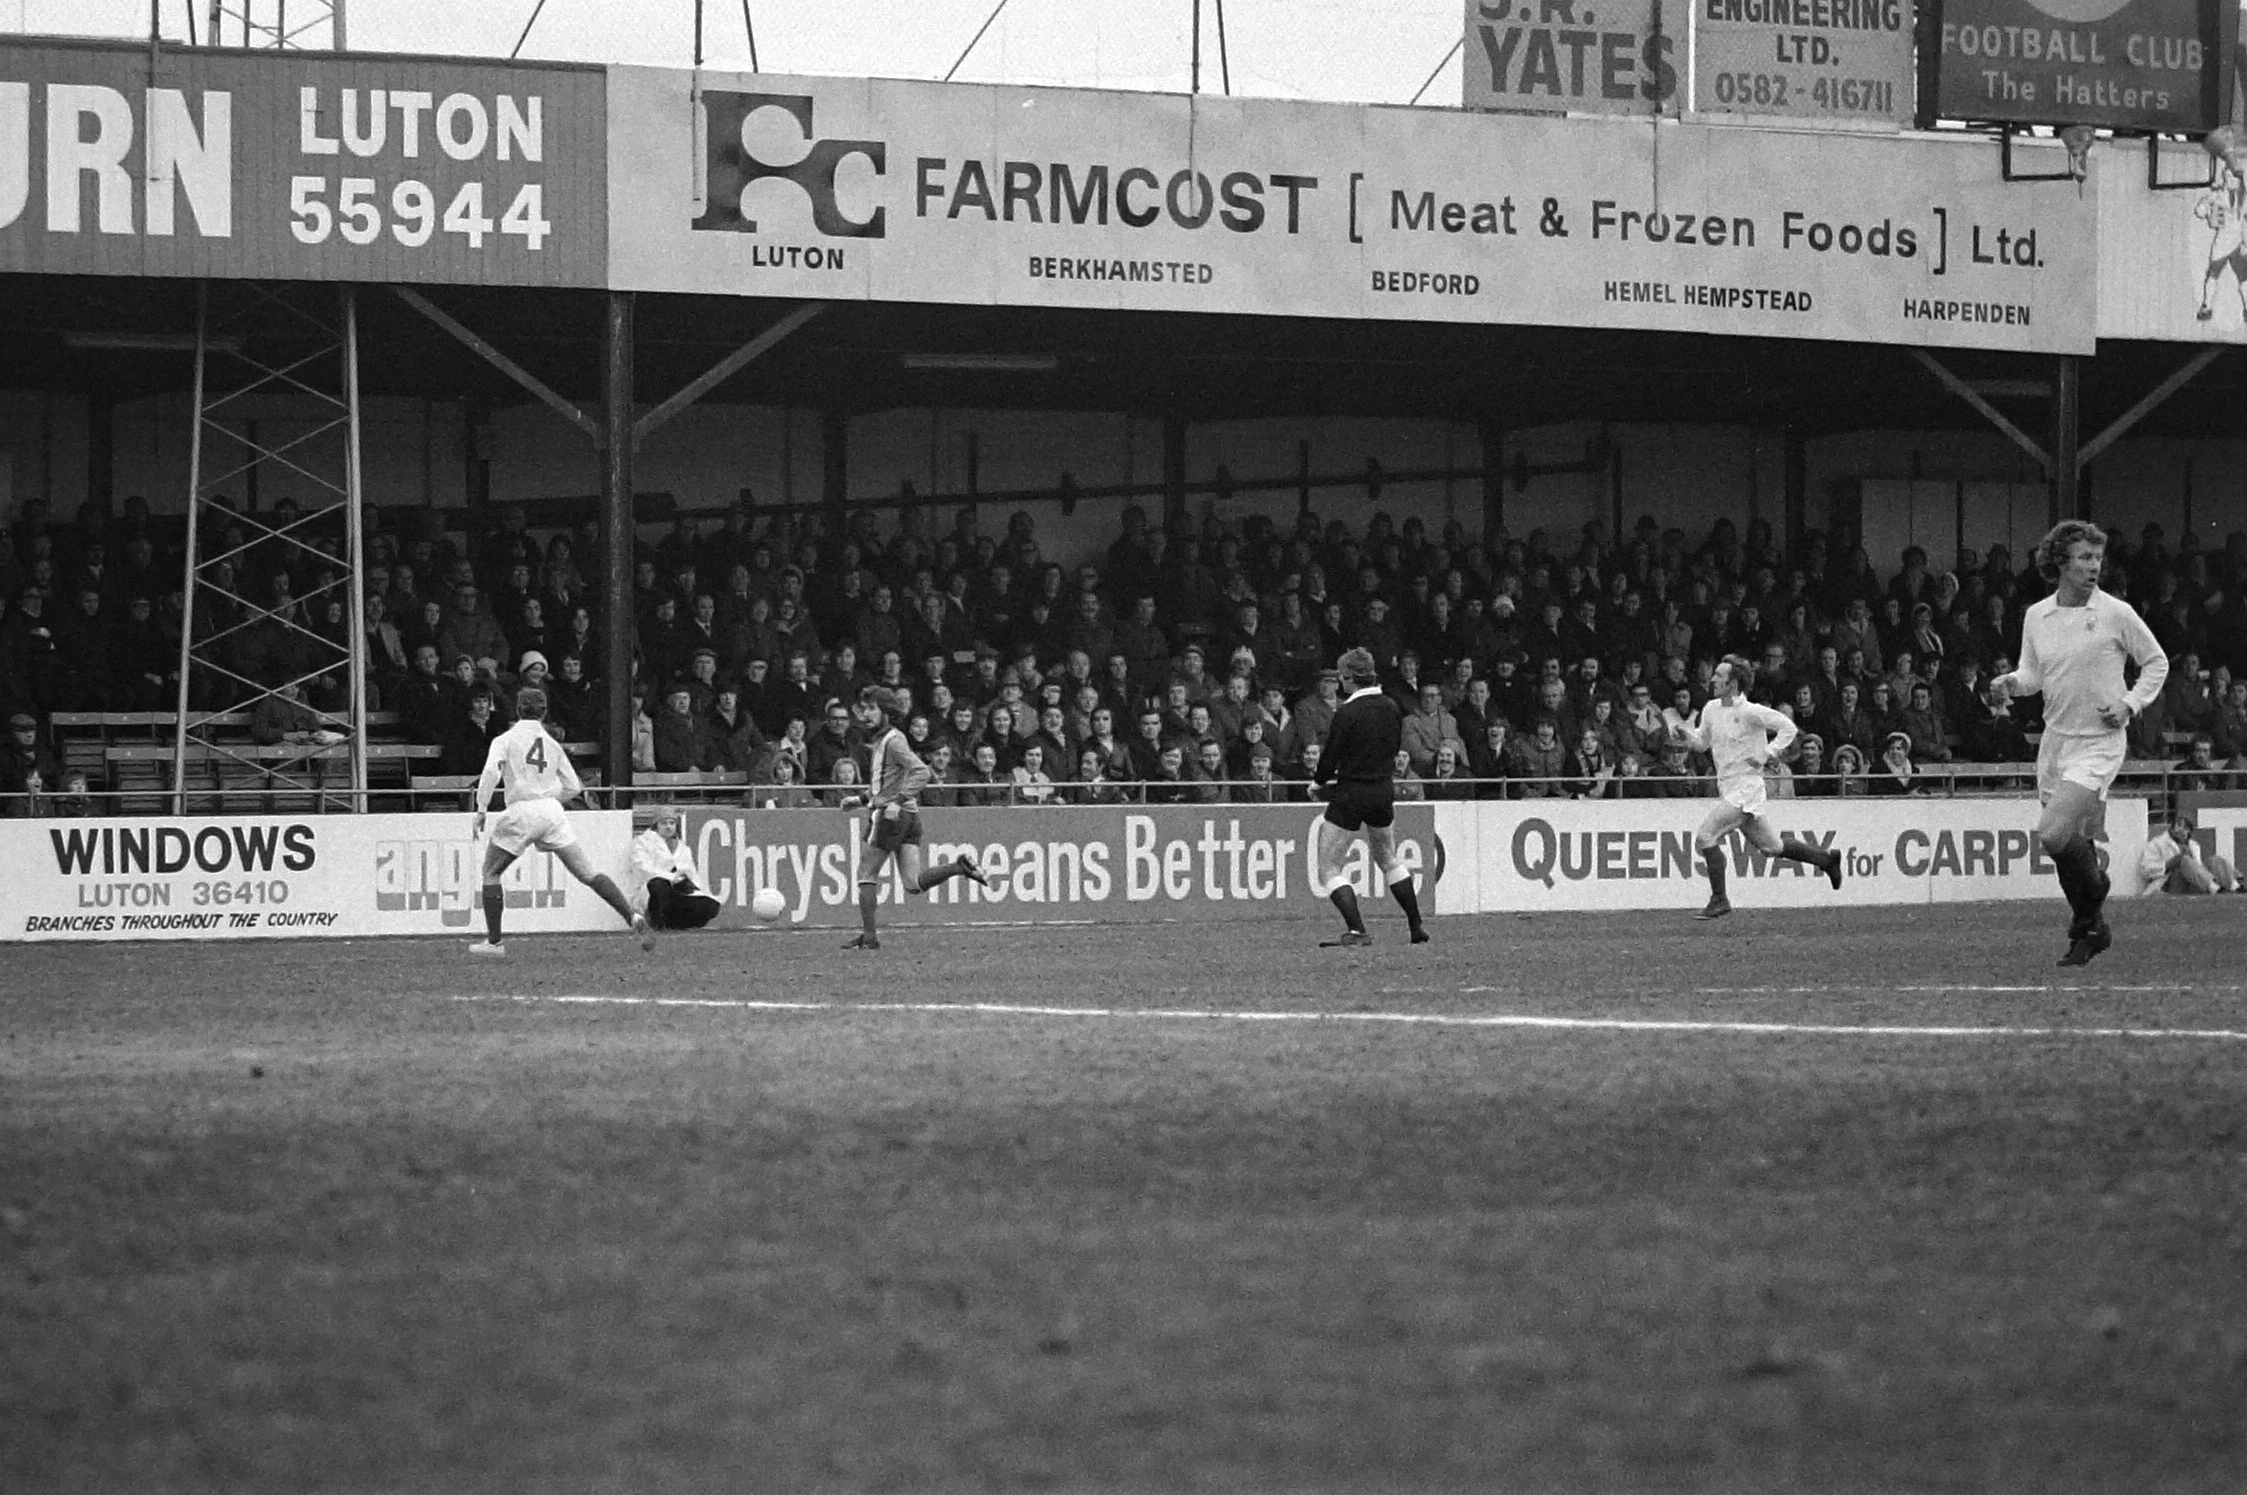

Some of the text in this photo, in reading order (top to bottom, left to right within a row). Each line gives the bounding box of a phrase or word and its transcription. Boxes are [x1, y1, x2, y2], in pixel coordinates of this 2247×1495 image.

[1706, 0, 1901, 31] ENGINEERING
[1477, 25, 1677, 101] YATES
[1776, 34, 1840, 67] LTD.
[1941, 22, 2205, 71] FOOTBALL CLUB
[1982, 69, 2171, 110] The Hatters
[299, 86, 543, 162] LUTON
[290, 175, 552, 250] 55944
[916, 157, 1319, 235] FARMCOST
[1540, 197, 1569, 238] &
[1592, 200, 1756, 248] Frozen
[1972, 224, 2045, 269] Ltd.
[752, 245, 845, 271] LUTON
[1028, 256, 1214, 284] BERKHAMSTED
[1371, 270, 1480, 297] BEDFORD
[1603, 280, 1813, 313] HEMEL HEMPSTEAD
[1903, 297, 2032, 327] HARPENDEN
[525, 736, 548, 774] 4
[50, 825, 317, 876] WINDOWS
[698, 817, 904, 923] Chrysl
[928, 841, 1112, 904] means
[1125, 814, 1296, 901] Better
[1847, 846, 1884, 878] for
[1894, 828, 2110, 878] CARPE
[78, 879, 290, 908] LUTON 36410
[376, 839, 567, 927] angan
[25, 911, 339, 933] BRANCHES THROUGHOUT THE COUNTRY
